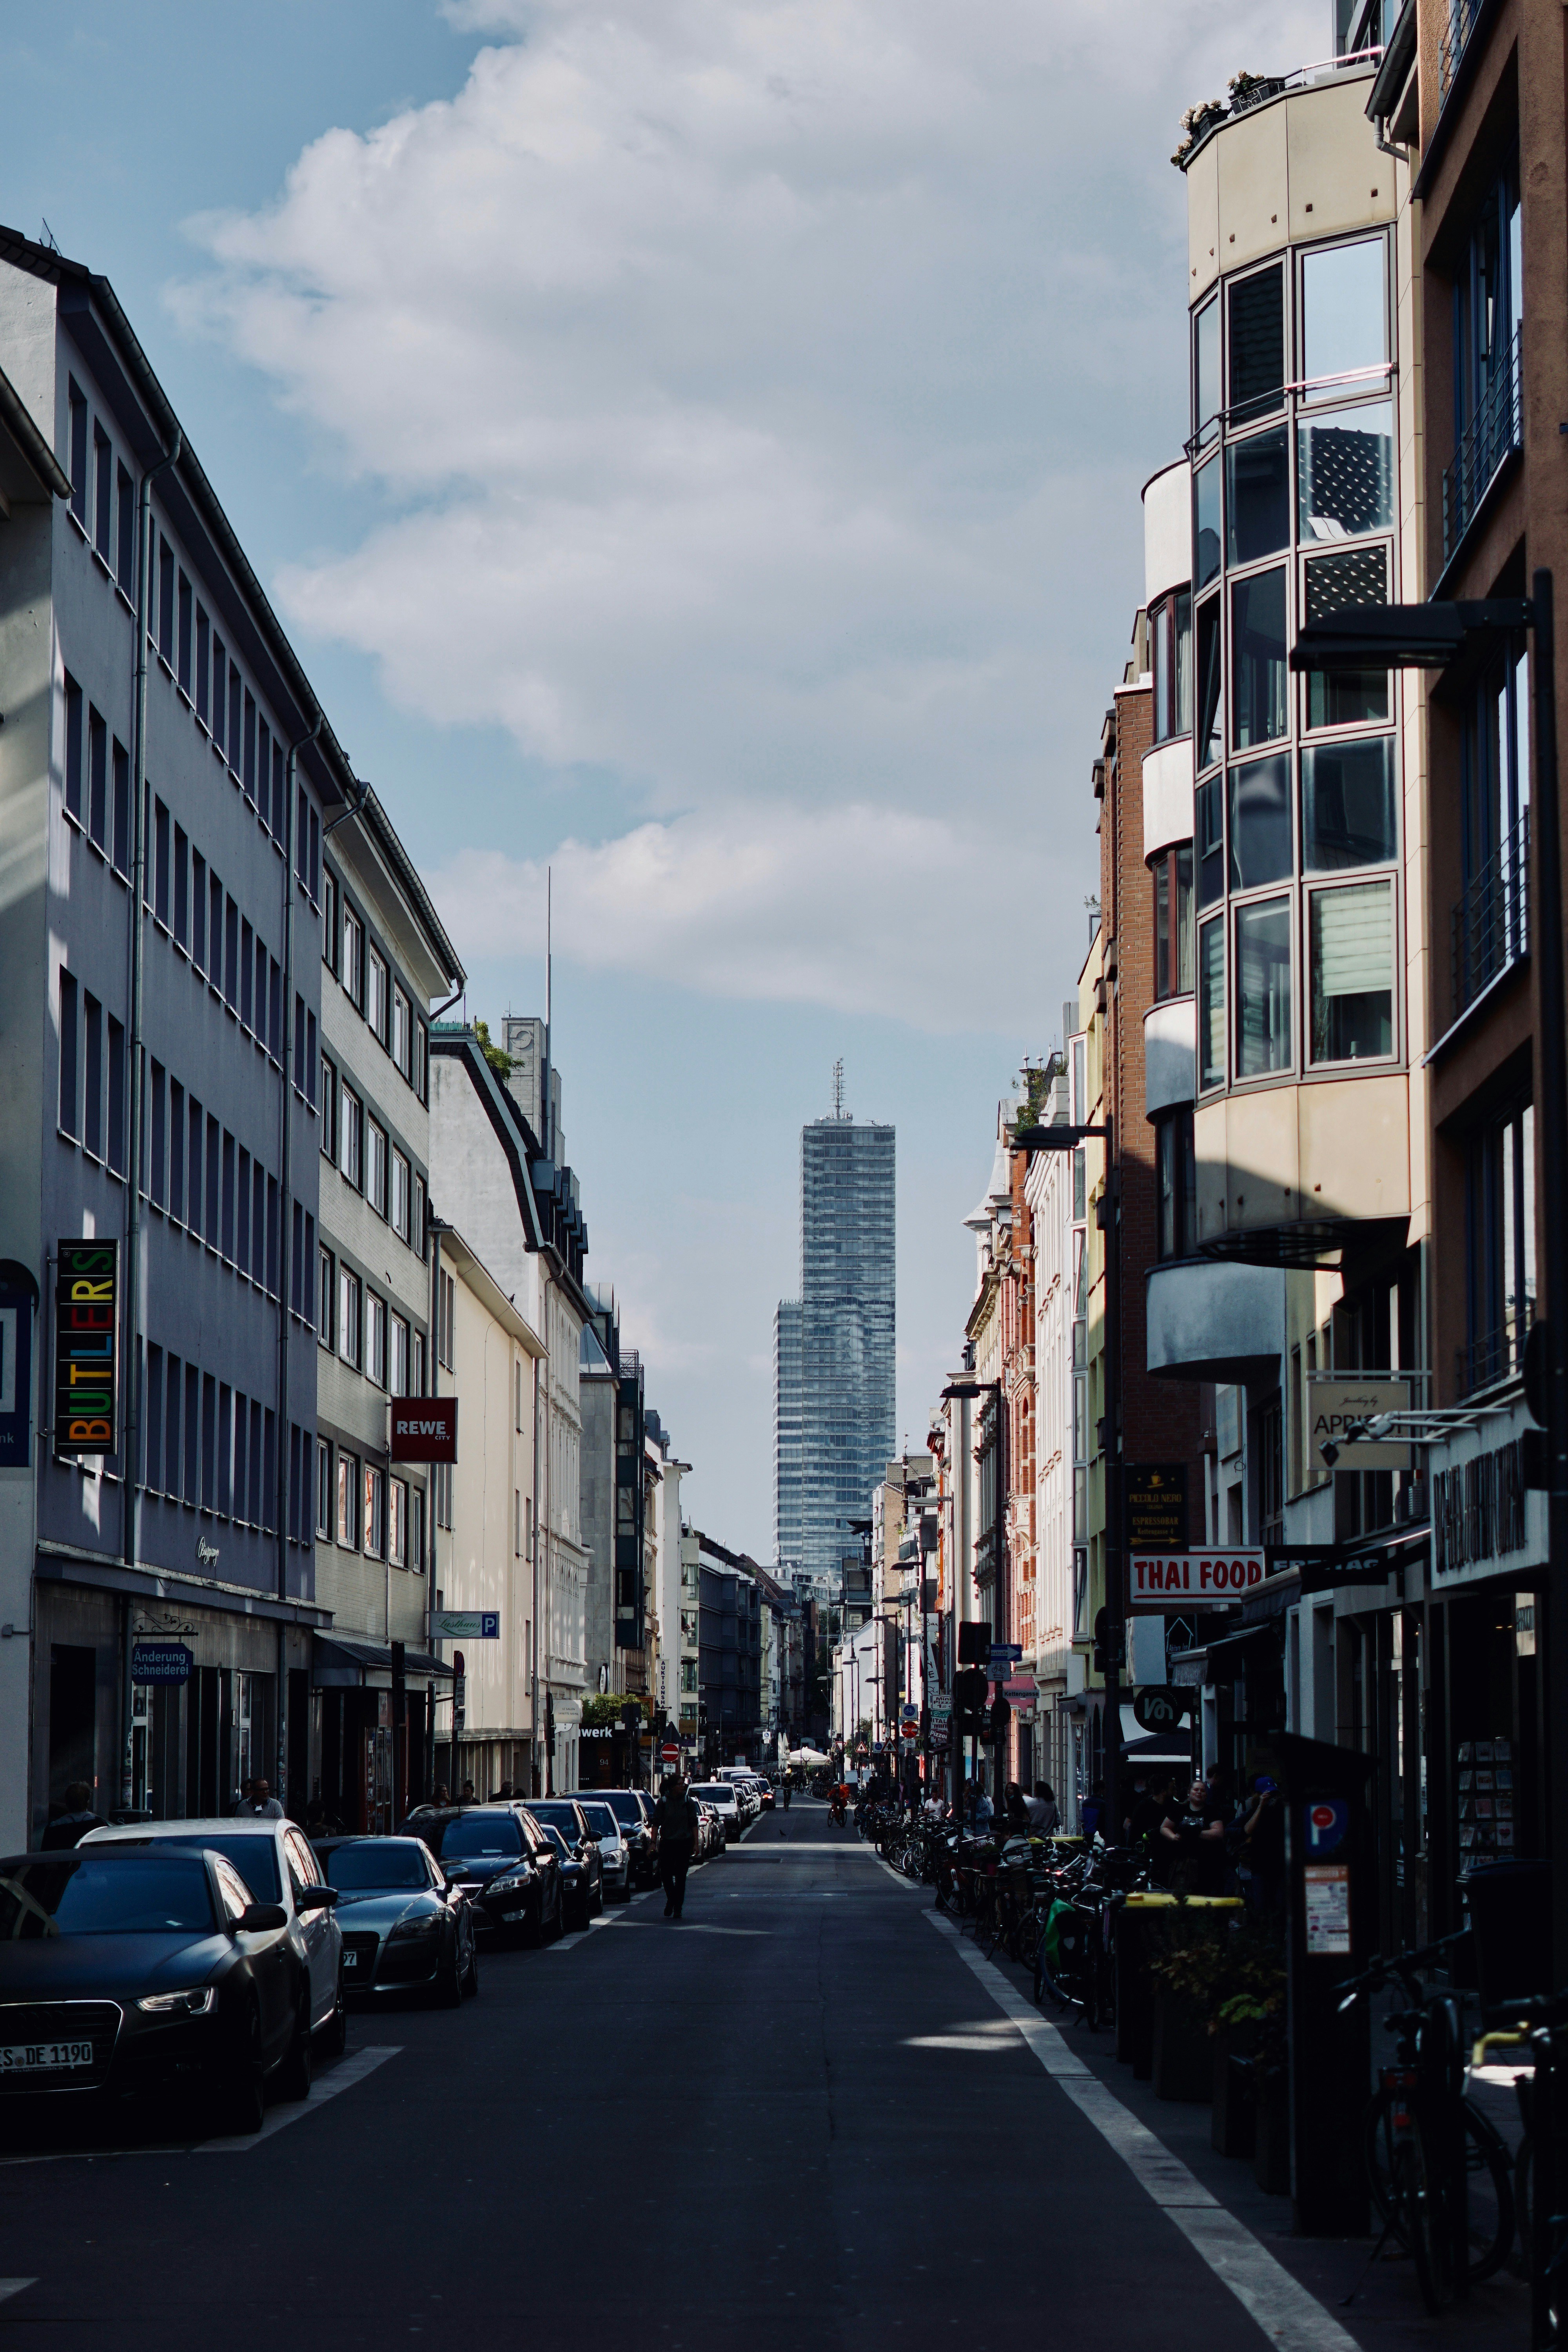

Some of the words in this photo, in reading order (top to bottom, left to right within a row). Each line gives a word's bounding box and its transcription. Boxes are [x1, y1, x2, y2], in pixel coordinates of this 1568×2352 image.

[69, 1251, 113, 1440] BUTLERS
[397, 1421, 446, 1435] REWE
[1129, 1494, 1159, 1503] PICCOLO
[1161, 1494, 1182, 1503] NERO
[1132, 1517, 1179, 1525] ESPRESSOBAR
[1134, 1561, 1189, 1590] THAI
[1200, 1560, 1262, 1589] FOOD
[134, 1648, 185, 1665] Änderung
[132, 1663, 189, 1675] Schneiderei
[0, 2048, 13, 2067] S
[26, 2046, 46, 2065] DE
[51, 2043, 91, 2063] 1190
